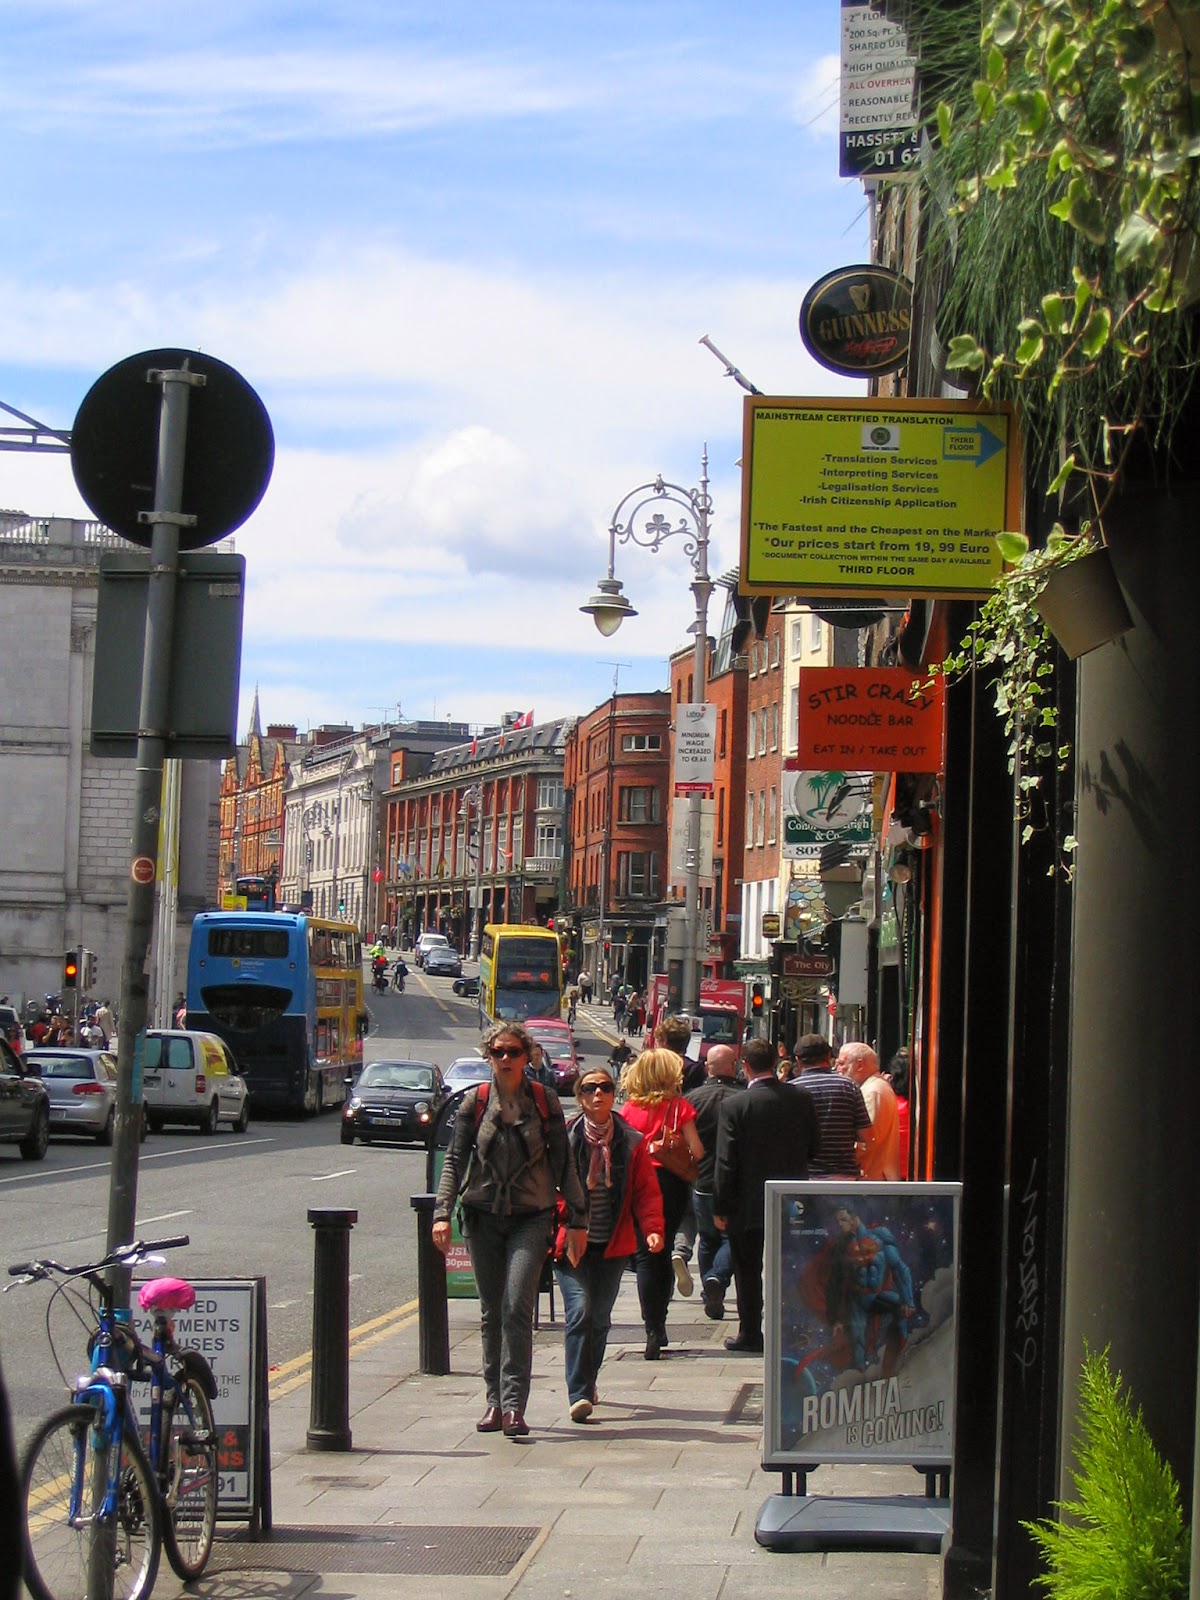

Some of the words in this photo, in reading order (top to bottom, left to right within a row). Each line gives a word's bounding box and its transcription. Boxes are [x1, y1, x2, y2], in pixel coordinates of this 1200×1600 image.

[849, 30, 865, 39] 200
[849, 41, 886, 52] SHARED
[849, 62, 873, 72] HIGH
[848, 82, 865, 90] ALL
[867, 78, 914, 88] OVERHEA
[848, 95, 909, 107] REASONABLE
[848, 113, 893, 125] RECENTLY
[874, 149, 894, 166] 01
[901, 147, 921, 164] 67
[820, 308, 909, 340] GUINNESS
[756, 412, 823, 421] MAINSTREAM
[826, 414, 879, 423] CERTIFIED
[882, 415, 954, 425] TRANSLATION
[890, 456, 938, 466] Services
[891, 470, 939, 479] Services
[892, 484, 939, 494] Services
[830, 496, 891, 508] Citizenship
[894, 498, 957, 508] Application
[782, 523, 823, 532] Fastest
[826, 525, 846, 533] and
[850, 525, 867, 533] the
[870, 526, 923, 536] Cheapest
[943, 528, 960, 536] the
[964, 528, 1002, 537] Marke
[798, 539, 839, 550] prices
[843, 540, 875, 550] start
[879, 541, 910, 551] from
[939, 542, 955, 552] 99
[960, 543, 990, 554] Euro
[838, 565, 873, 574] THIRD
[876, 566, 915, 575] FLOOR
[808, 684, 858, 710] STIR
[867, 683, 934, 710] CRAZY
[827, 712, 882, 726] NOODLE
[888, 714, 914, 727] BAR
[813, 744, 836, 754] EAT
[840, 745, 855, 754] IN
[870, 746, 898, 755] TAKE
[902, 746, 926, 756] OUT
[794, 960, 811, 969] The
[221, 1374, 241, 1385] THE
[802, 1376, 901, 1434] ROMITA
[846, 1425, 859, 1445] IS
[861, 1400, 945, 1448] COMING!
